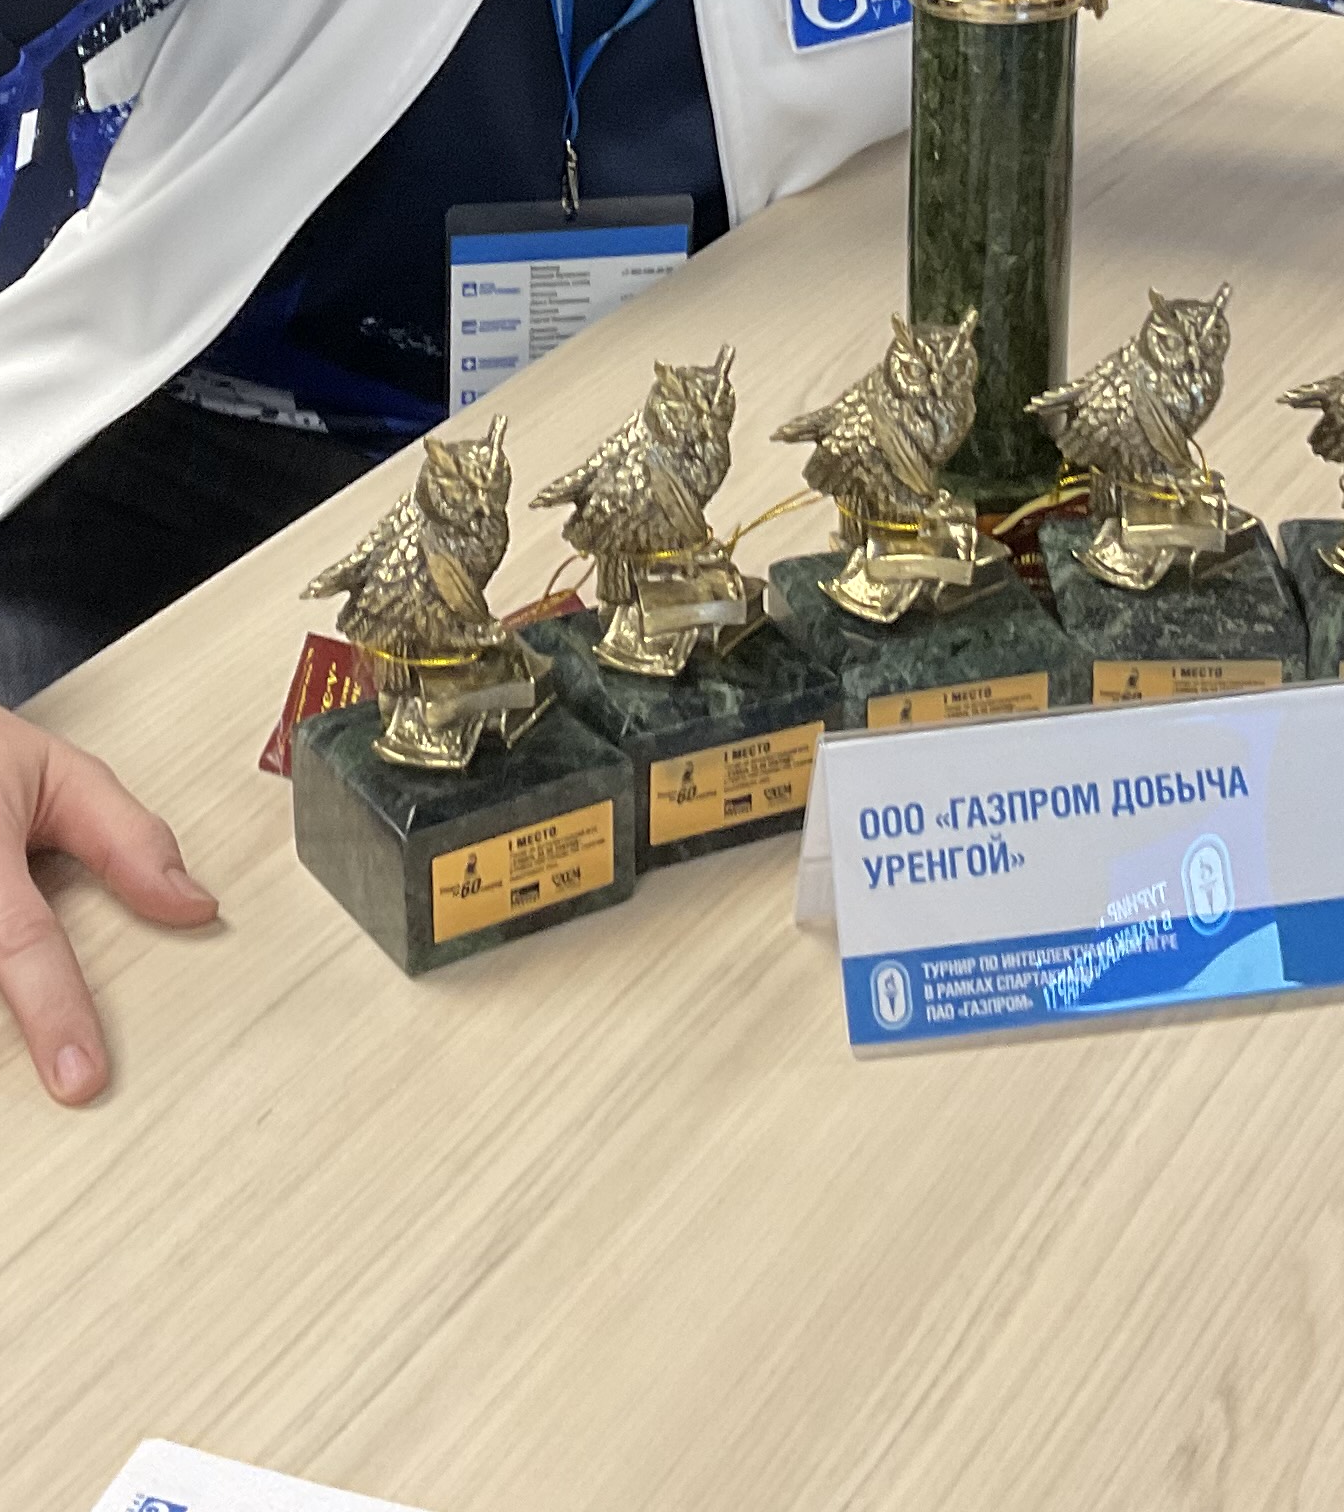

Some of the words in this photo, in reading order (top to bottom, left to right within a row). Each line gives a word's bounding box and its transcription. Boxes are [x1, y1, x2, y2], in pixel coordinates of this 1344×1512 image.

[859, 802, 925, 841] ООО
[935, 782, 1101, 831] «ГАЗПРОМ
[1111, 765, 1249, 818] ДОБЫЧА
[862, 832, 1026, 889] УРЕНГОЙ»
[921, 957, 977, 979] ТУРНИР
[979, 954, 998, 972] ПО
[924, 983, 935, 1001] В
[937, 975, 994, 1000] РАМКАХ
[926, 1003, 955, 1023] ПАО
[958, 993, 1033, 1017] «ГАЗПРОМ»
